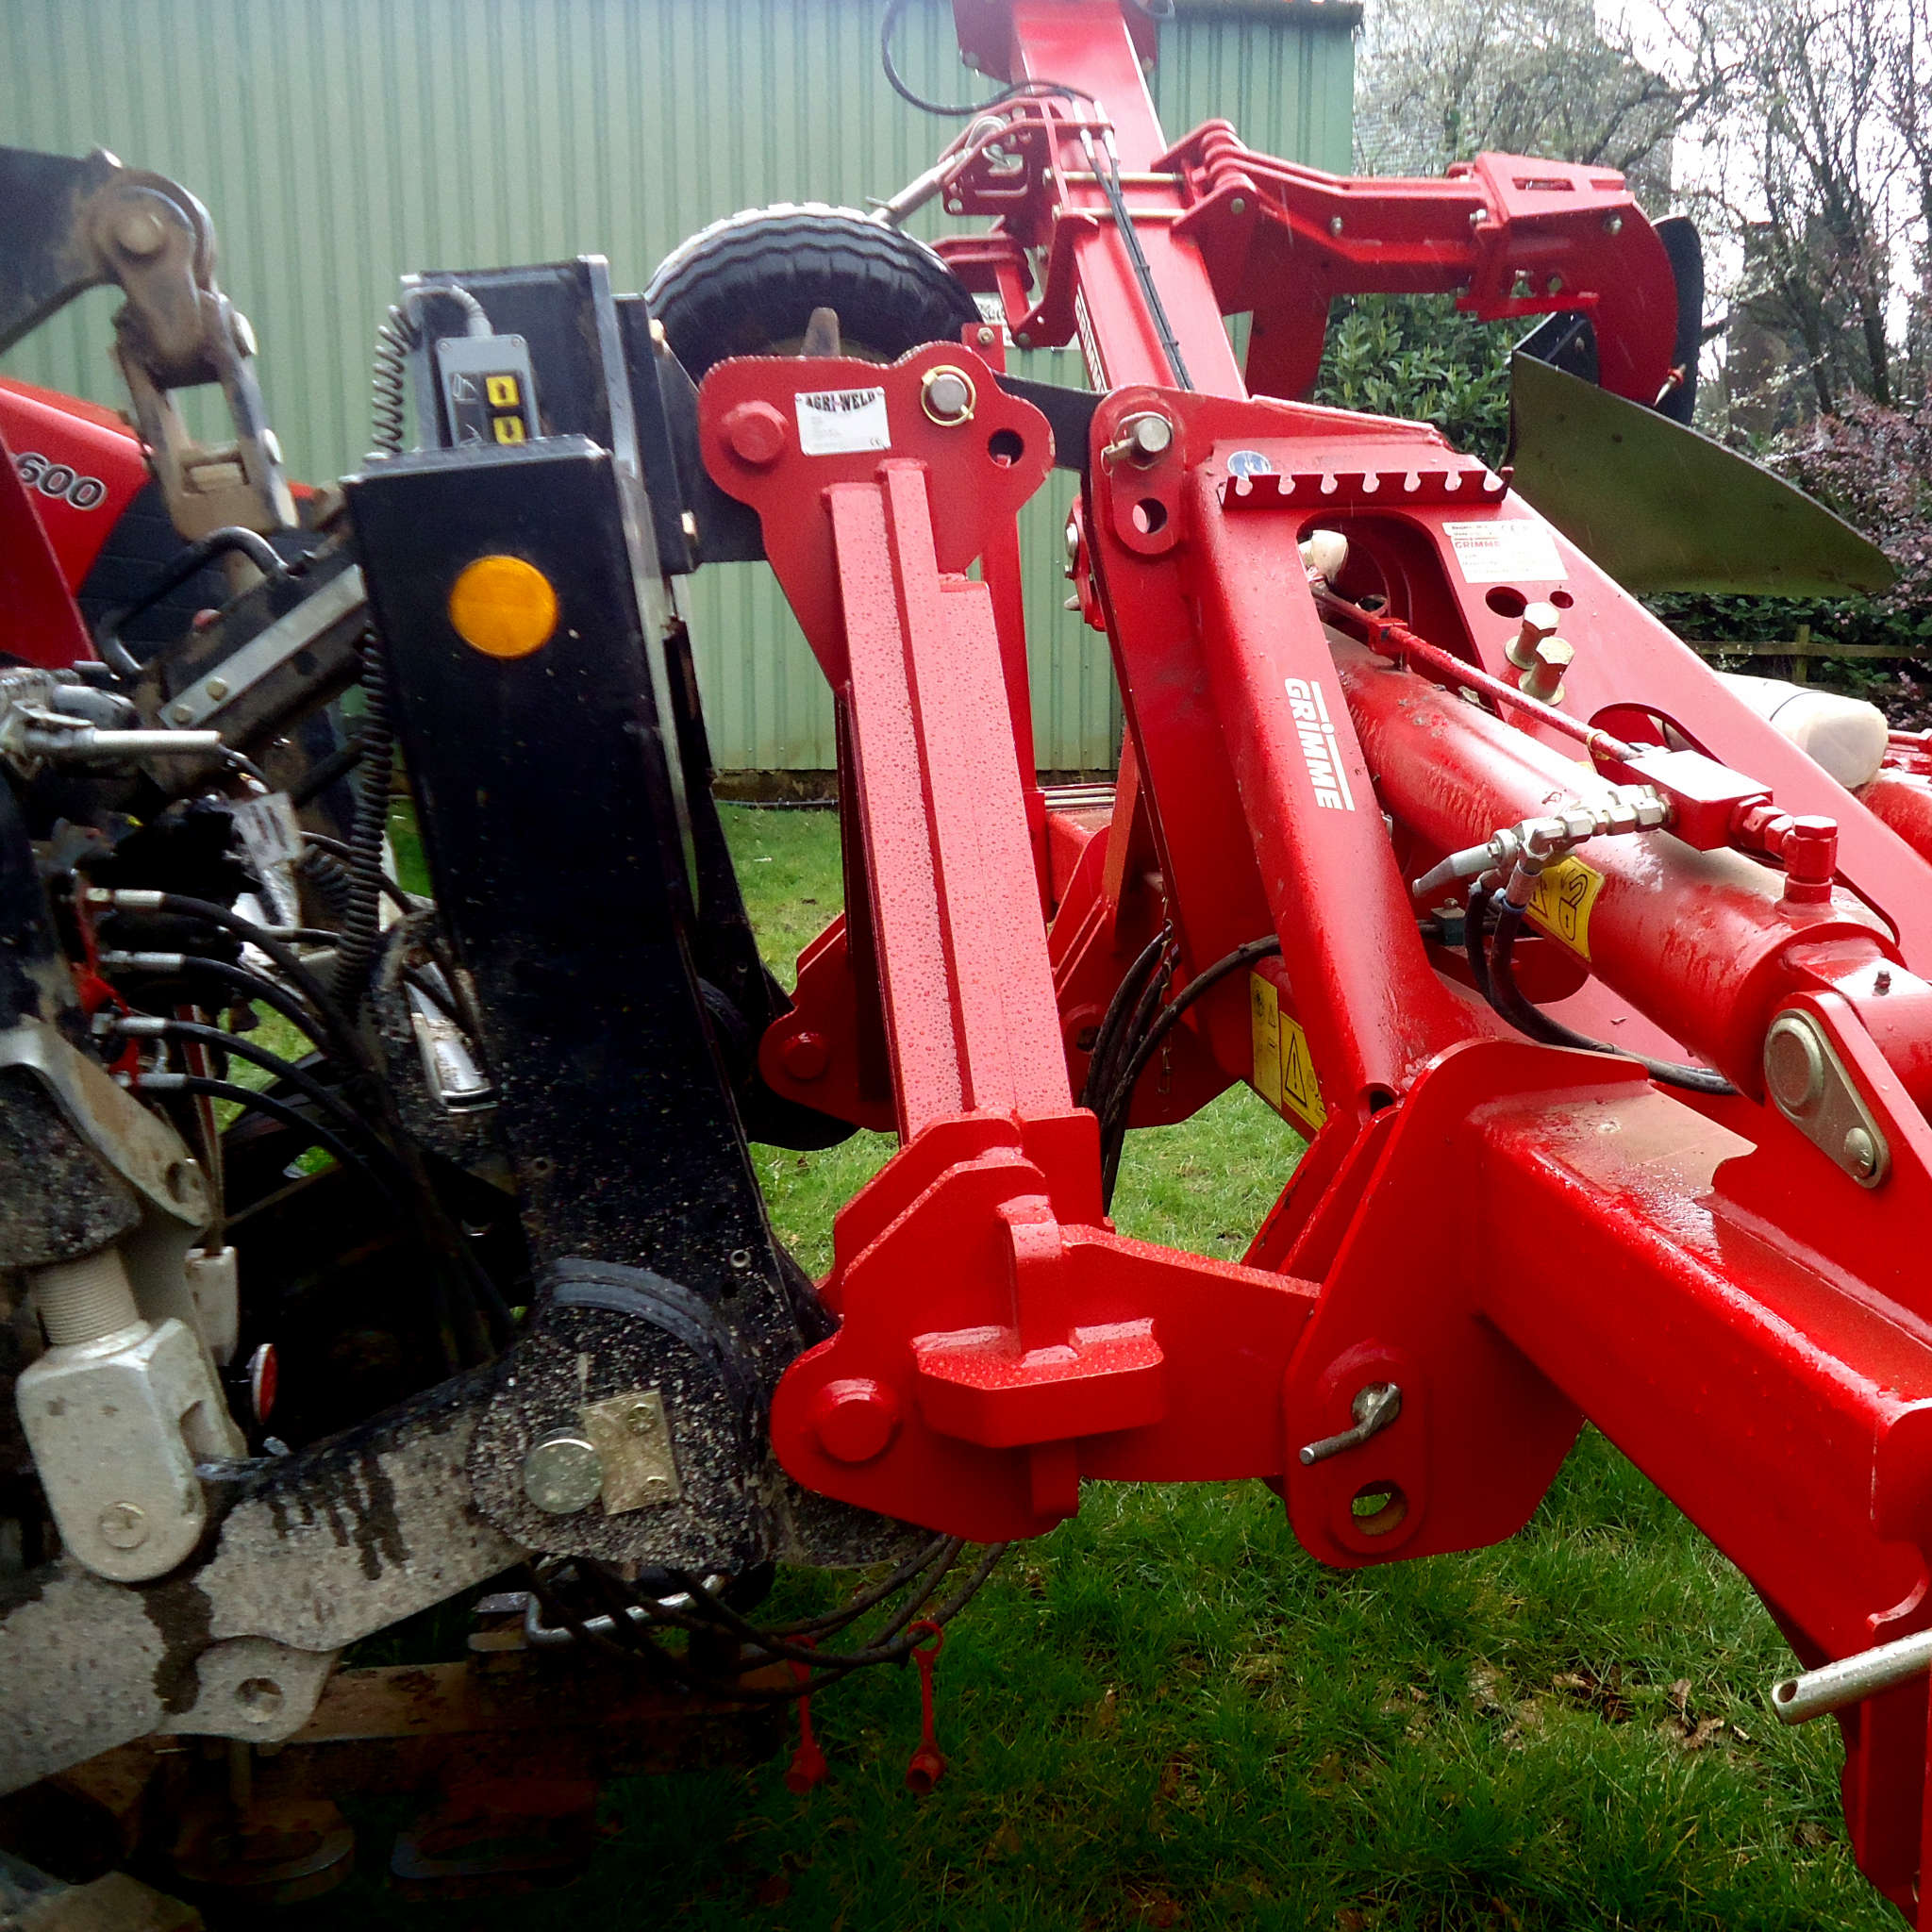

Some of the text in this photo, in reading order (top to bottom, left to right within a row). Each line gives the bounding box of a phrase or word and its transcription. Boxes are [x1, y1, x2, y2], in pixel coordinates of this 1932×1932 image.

[805, 391, 875, 412] AGRI-WELD
[1455, 541, 1501, 549] GRIMME
[1284, 678, 1346, 810] GRIMME
